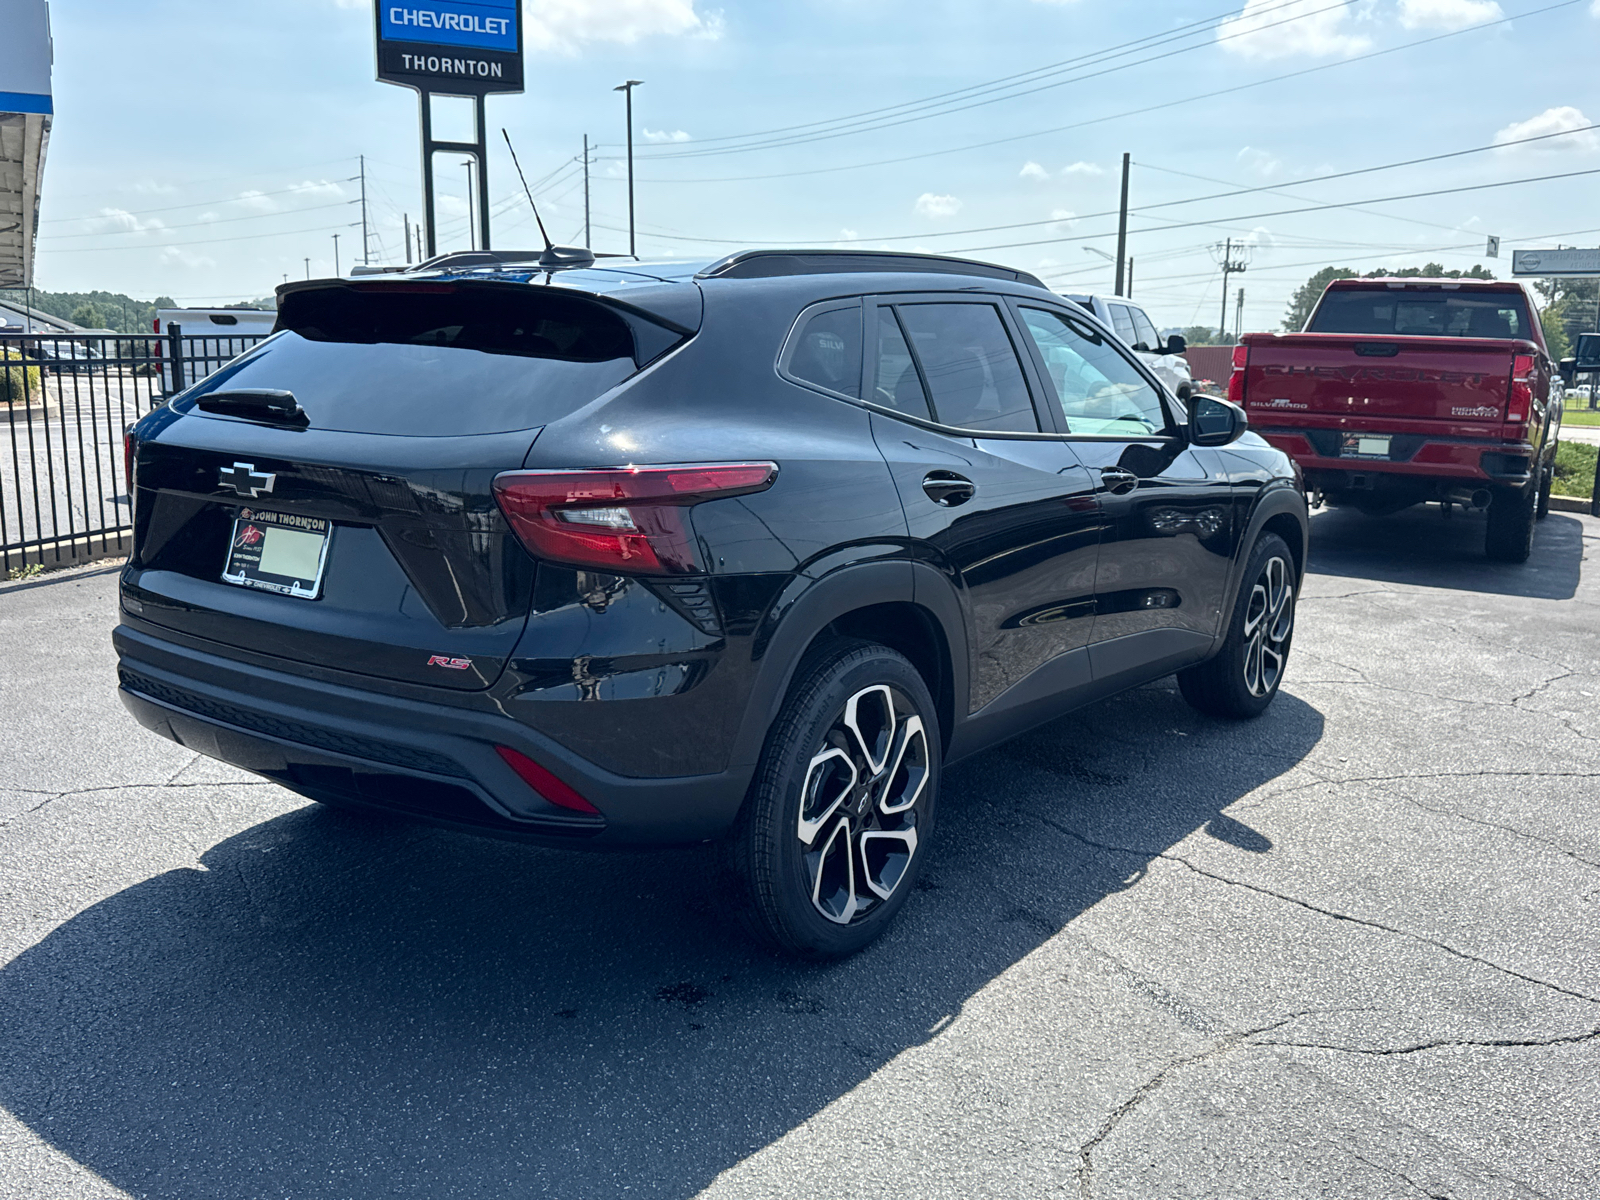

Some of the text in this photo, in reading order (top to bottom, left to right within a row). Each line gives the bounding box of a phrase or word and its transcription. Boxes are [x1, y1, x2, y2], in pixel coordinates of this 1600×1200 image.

[390, 7, 510, 35] CHEVROLET
[402, 54, 502, 77] THORNTON
[1263, 365, 1490, 384] CHEVROLET
[1250, 401, 1308, 409] SILVERADO
[256, 512, 325, 530] JOHN THORNTON
[253, 581, 282, 592] CHEVROLET
[427, 655, 472, 669] RS
